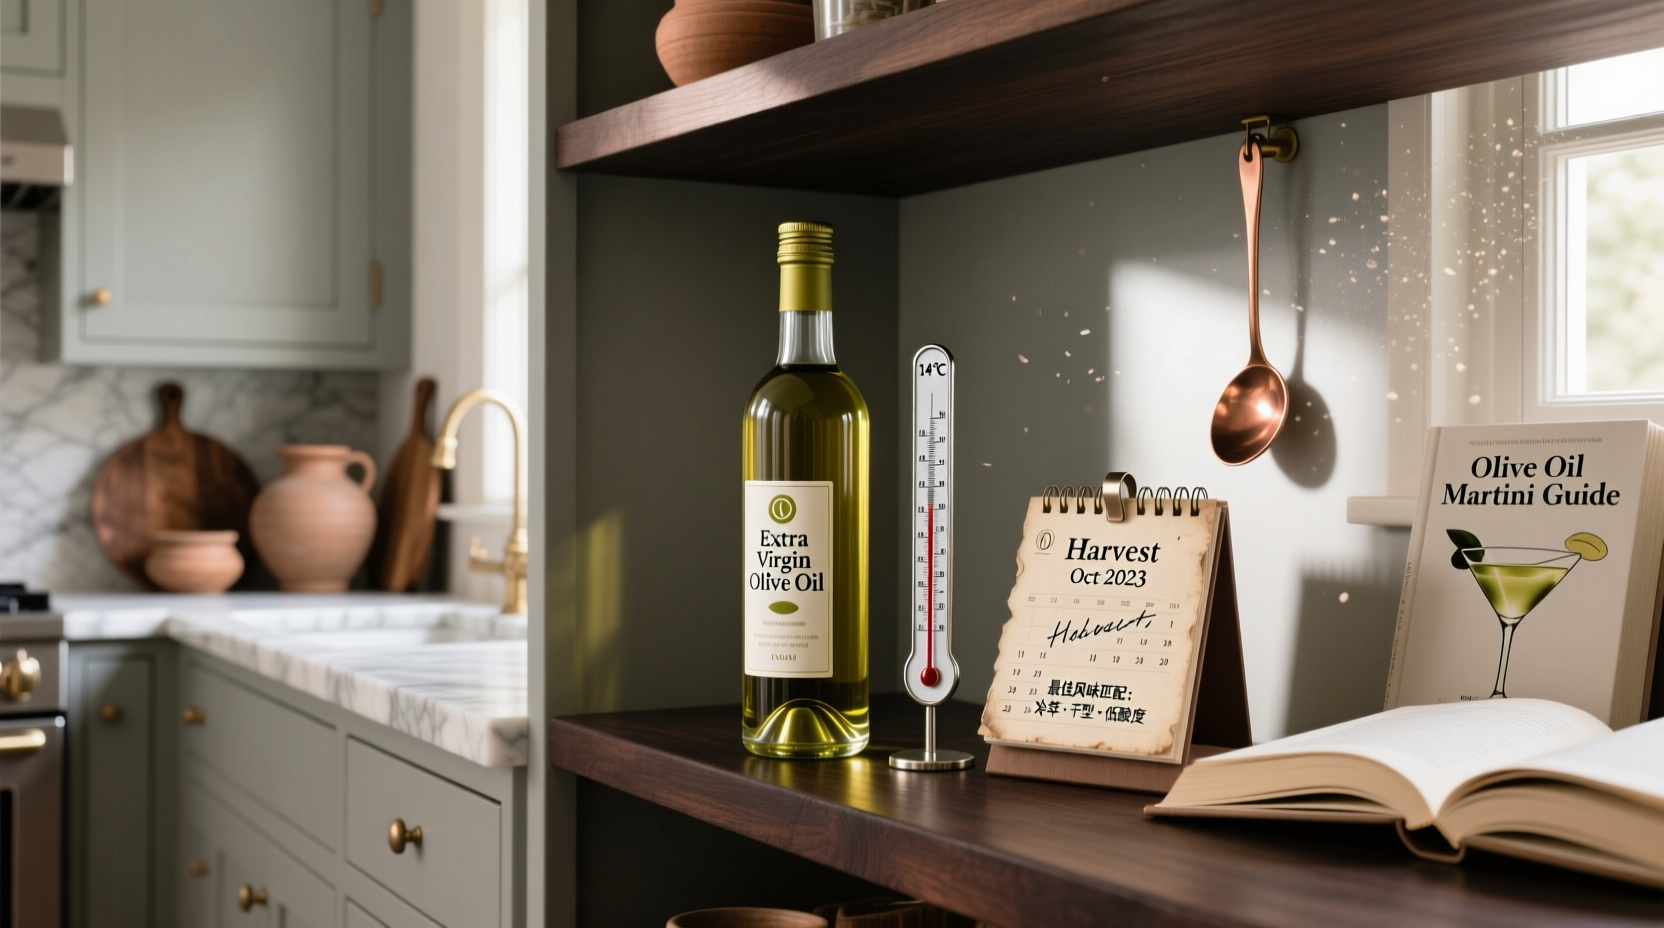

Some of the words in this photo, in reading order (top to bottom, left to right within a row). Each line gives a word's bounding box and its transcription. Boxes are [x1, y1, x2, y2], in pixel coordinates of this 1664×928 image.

[919, 362, 947, 376] 14°C
[1471, 455, 1538, 479] Olive
[1544, 453, 1585, 478] Oil
[1441, 483, 1535, 506] Martini
[1542, 481, 1621, 506] Guide
[760, 529, 809, 547] Extra
[1065, 537, 1161, 563] Harvest
[757, 550, 811, 574] Virgin
[749, 572, 791, 592] Olive
[795, 572, 824, 592] Oil
[1070, 567, 1101, 585] Oct
[1103, 568, 1147, 588] 2023
